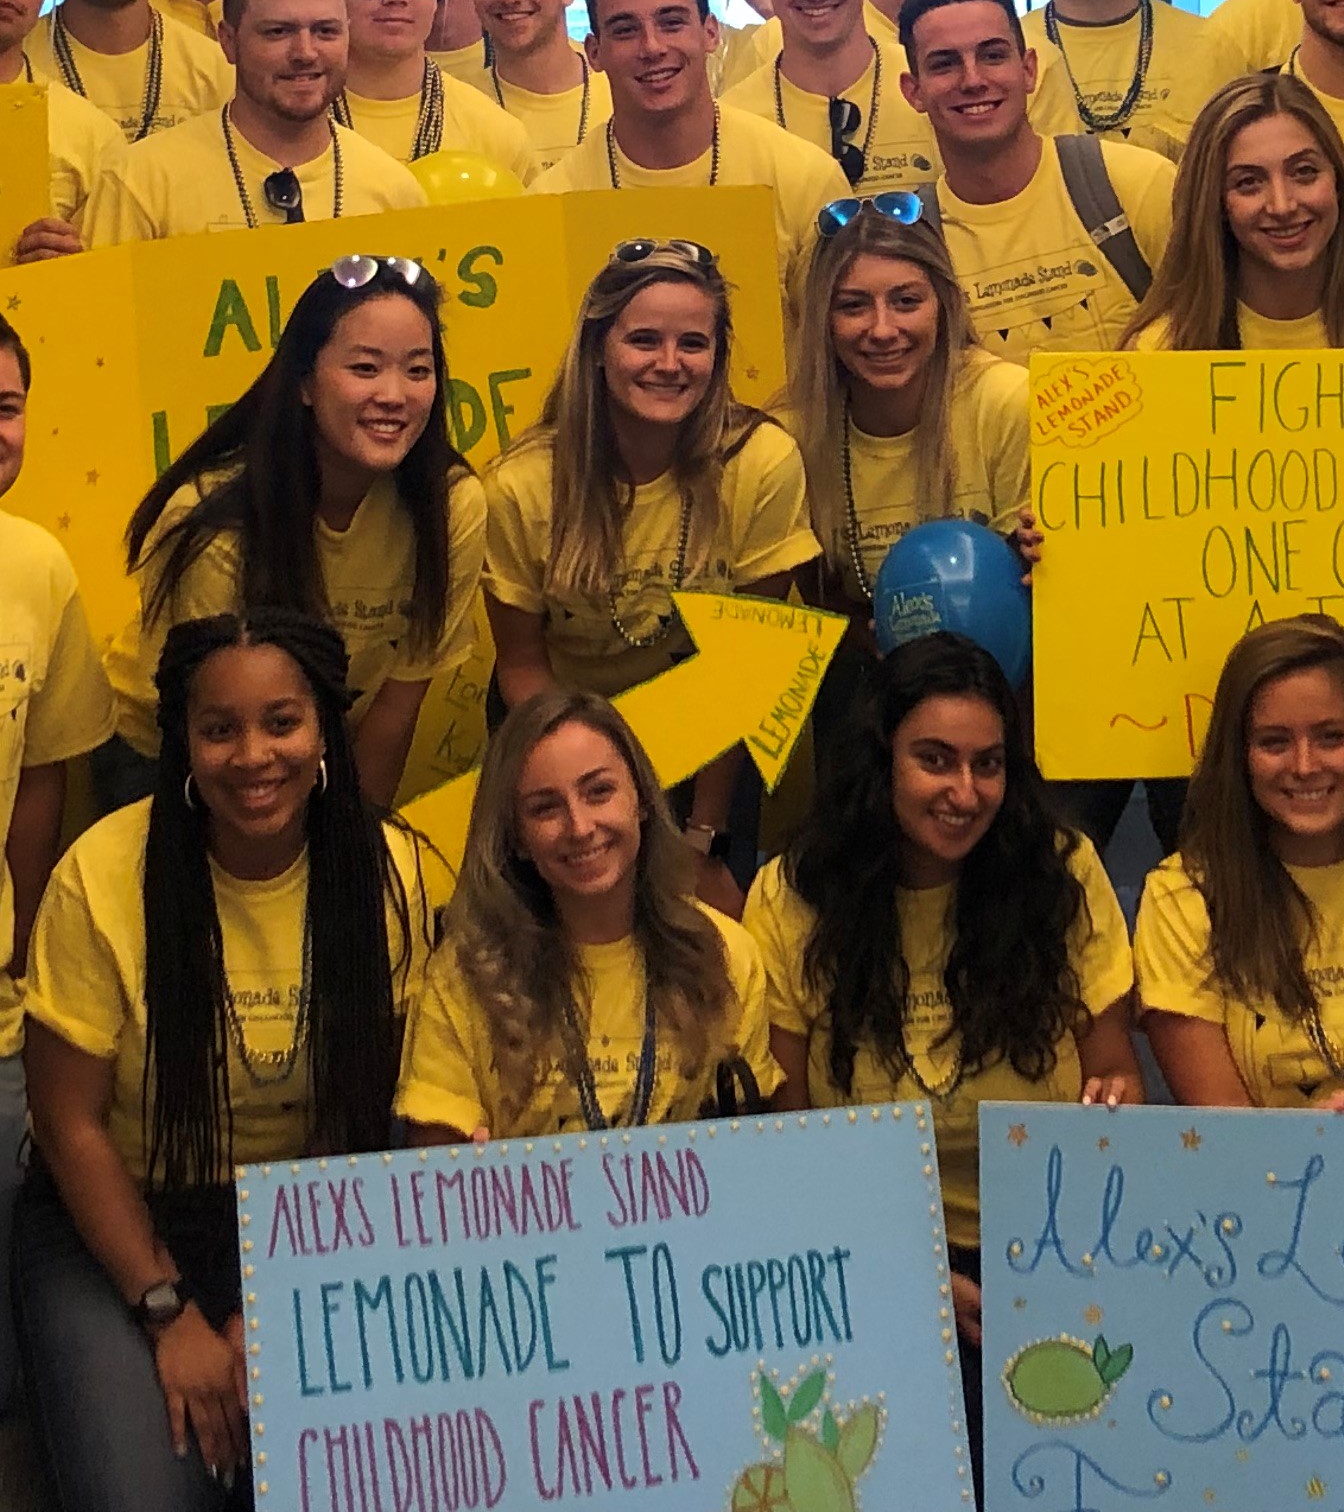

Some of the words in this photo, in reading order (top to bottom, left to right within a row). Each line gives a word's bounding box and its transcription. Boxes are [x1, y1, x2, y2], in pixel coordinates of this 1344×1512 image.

[203, 245, 504, 357] AL'S
[1036, 365, 1090, 410] ALEX'S
[1036, 363, 1125, 436] LEMONADE
[1067, 391, 1133, 439] STAND
[1038, 448, 1338, 531] CHILDHOOD
[1201, 518, 1308, 599] ONE
[710, 600, 825, 637] LEMONADE
[1131, 597, 1195, 666] AT
[747, 641, 827, 761] LEMONADE
[267, 1175, 375, 1261] ALEXS
[390, 1156, 583, 1250] LEMONADE
[602, 1146, 713, 1229] STAND
[1006, 1144, 1244, 1290] Alex's
[292, 1254, 571, 1397] LEMONADE
[604, 1241, 684, 1367] TO
[701, 1245, 855, 1359] SUPPORT
[297, 1406, 508, 1512] CHILDHOOD
[529, 1380, 702, 1504] CANCER
